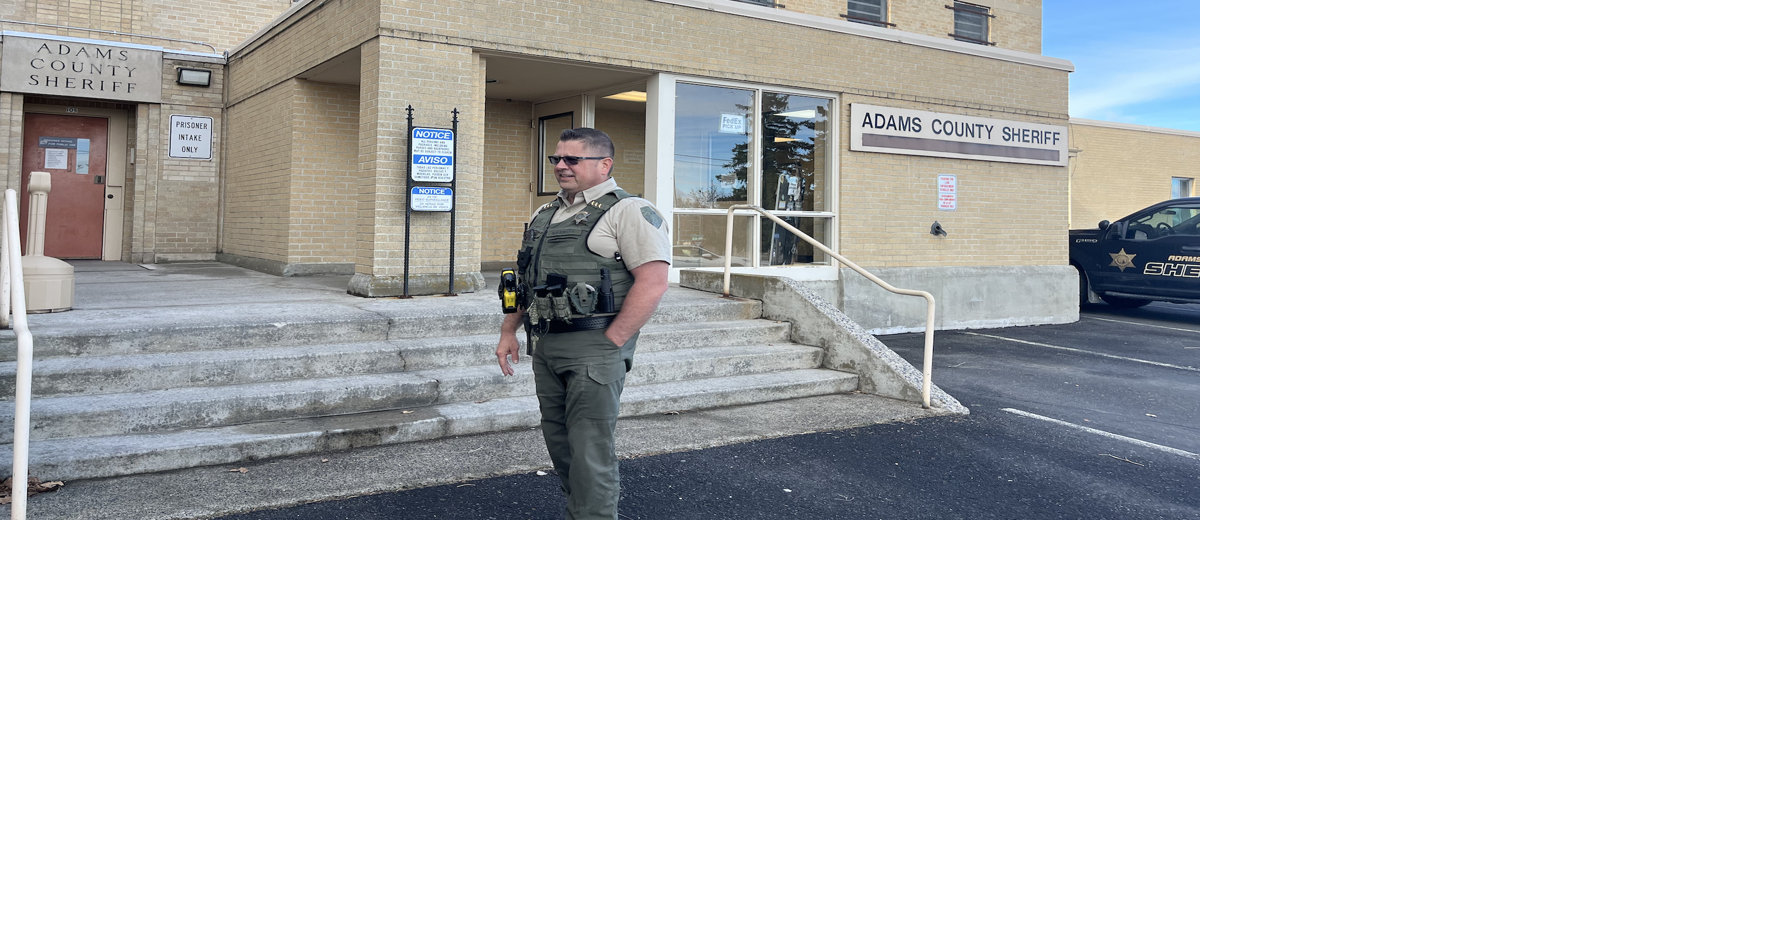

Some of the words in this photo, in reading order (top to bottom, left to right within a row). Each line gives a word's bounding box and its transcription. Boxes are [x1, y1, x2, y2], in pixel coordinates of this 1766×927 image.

[37, 43, 129, 61] ADAMS
[30, 58, 137, 78] COUNTY
[28, 74, 137, 93] SHERIFF
[722, 116, 742, 125] FedEx
[175, 121, 208, 130] PRISONER
[862, 112, 922, 132] ADAMS
[931, 118, 994, 140] COUNTY
[1002, 126, 1060, 146] SHERIFF
[416, 131, 450, 139] NOTICE
[418, 156, 448, 164] AVISO
[1168, 255, 1200, 263] ADAMS
